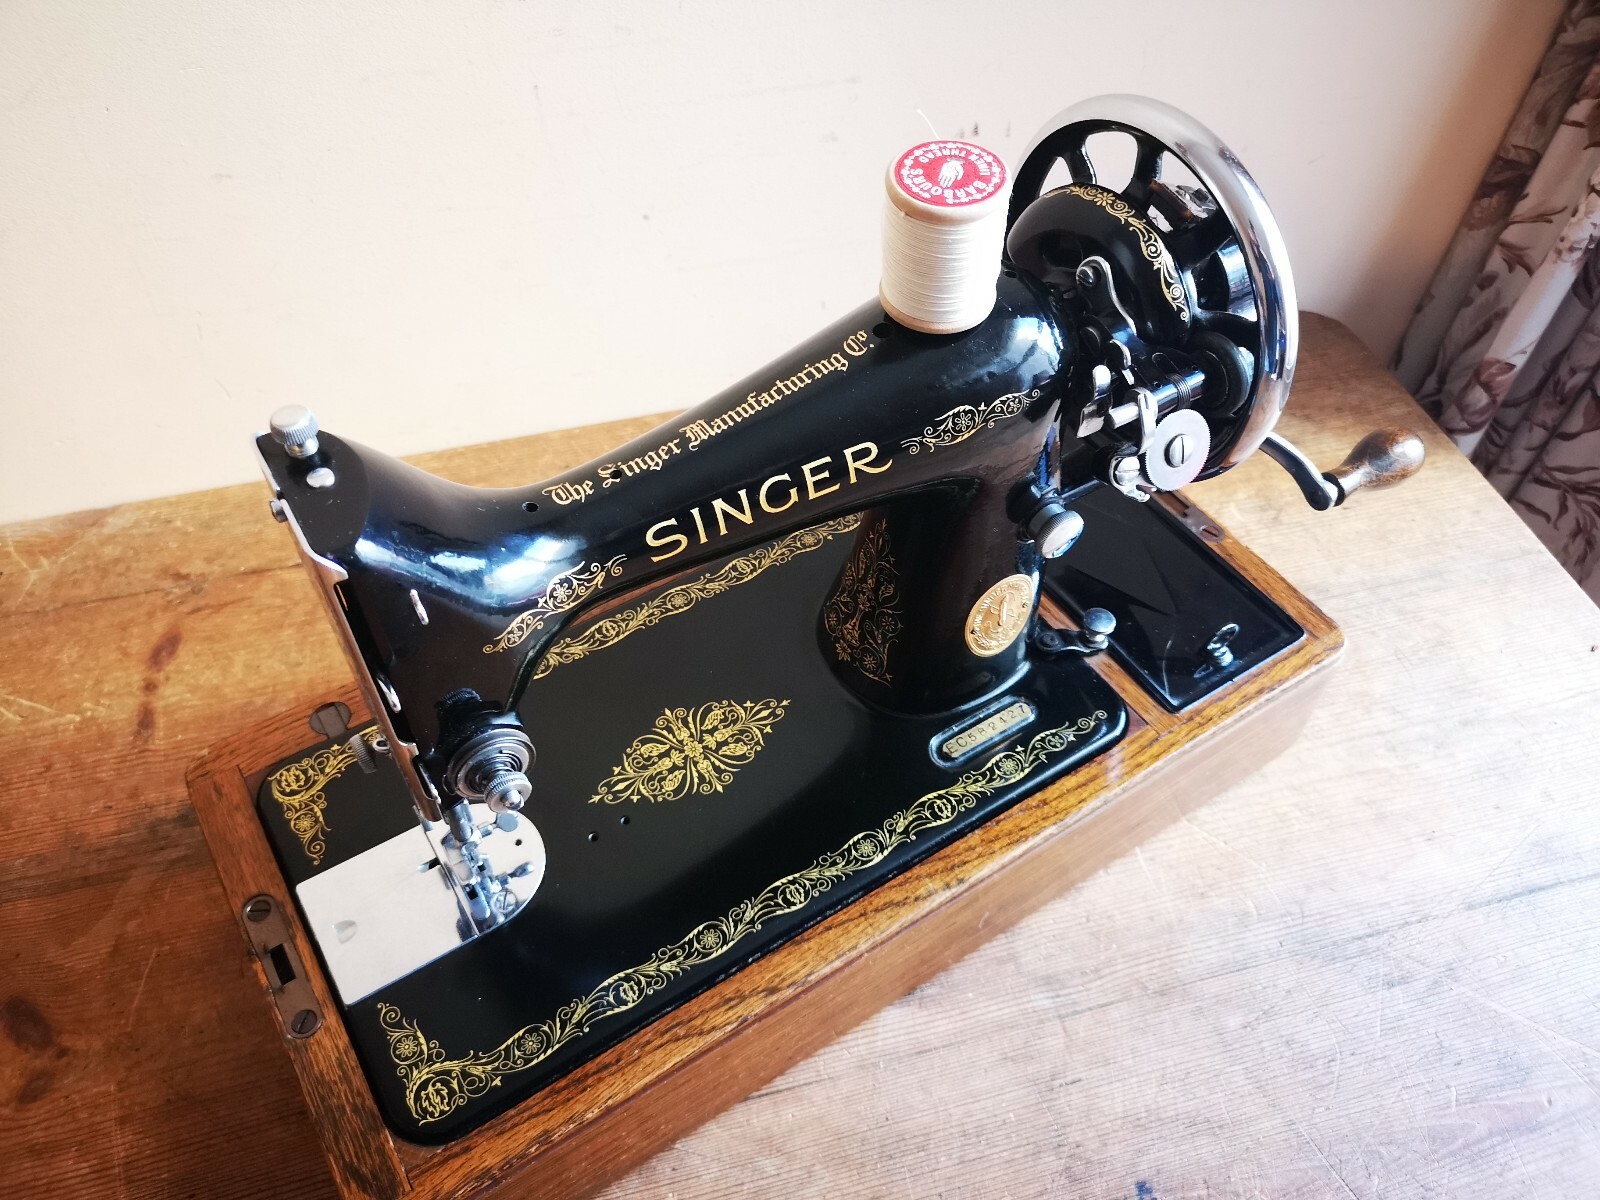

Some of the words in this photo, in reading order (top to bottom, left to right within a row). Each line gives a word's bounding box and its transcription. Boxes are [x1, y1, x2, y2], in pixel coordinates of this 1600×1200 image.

[910, 168, 988, 199] BARBOUR'S
[919, 148, 967, 163] THREAD
[541, 479, 595, 506] The
[597, 438, 682, 488] Singer
[679, 351, 849, 451] Manufacturing
[645, 440, 893, 563] SINGER
